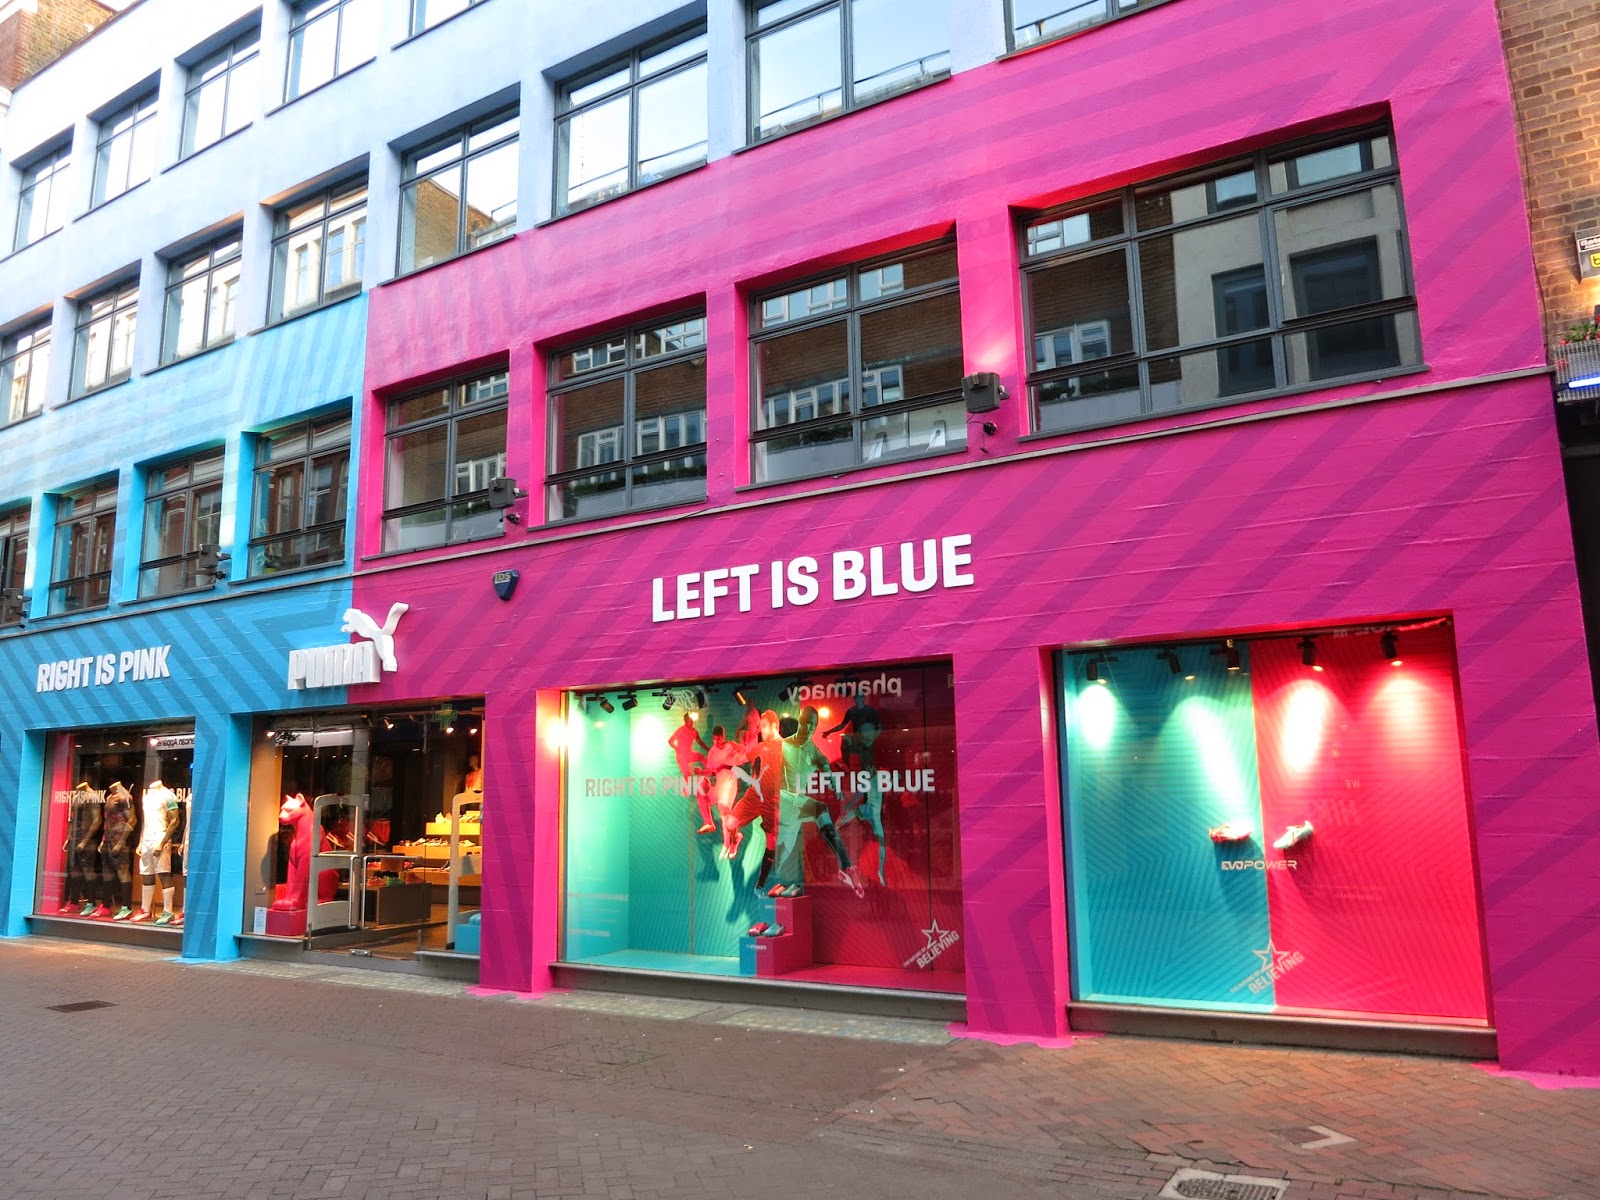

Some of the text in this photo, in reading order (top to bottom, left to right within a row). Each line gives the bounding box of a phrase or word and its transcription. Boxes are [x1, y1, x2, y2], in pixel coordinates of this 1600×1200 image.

[652, 534, 975, 623] LEFT IS BLUE
[36, 645, 172, 693] RIGHT IS PINK
[287, 640, 381, 691] PUMA
[54, 790, 78, 804] RIGHT
[86, 789, 107, 804] PINK
[585, 775, 706, 798] RIGHT IS PINK
[795, 768, 936, 795] LEFT IS BLUE
[916, 930, 960, 969] BELIEVING
[1248, 951, 1304, 995] BELIEVING
